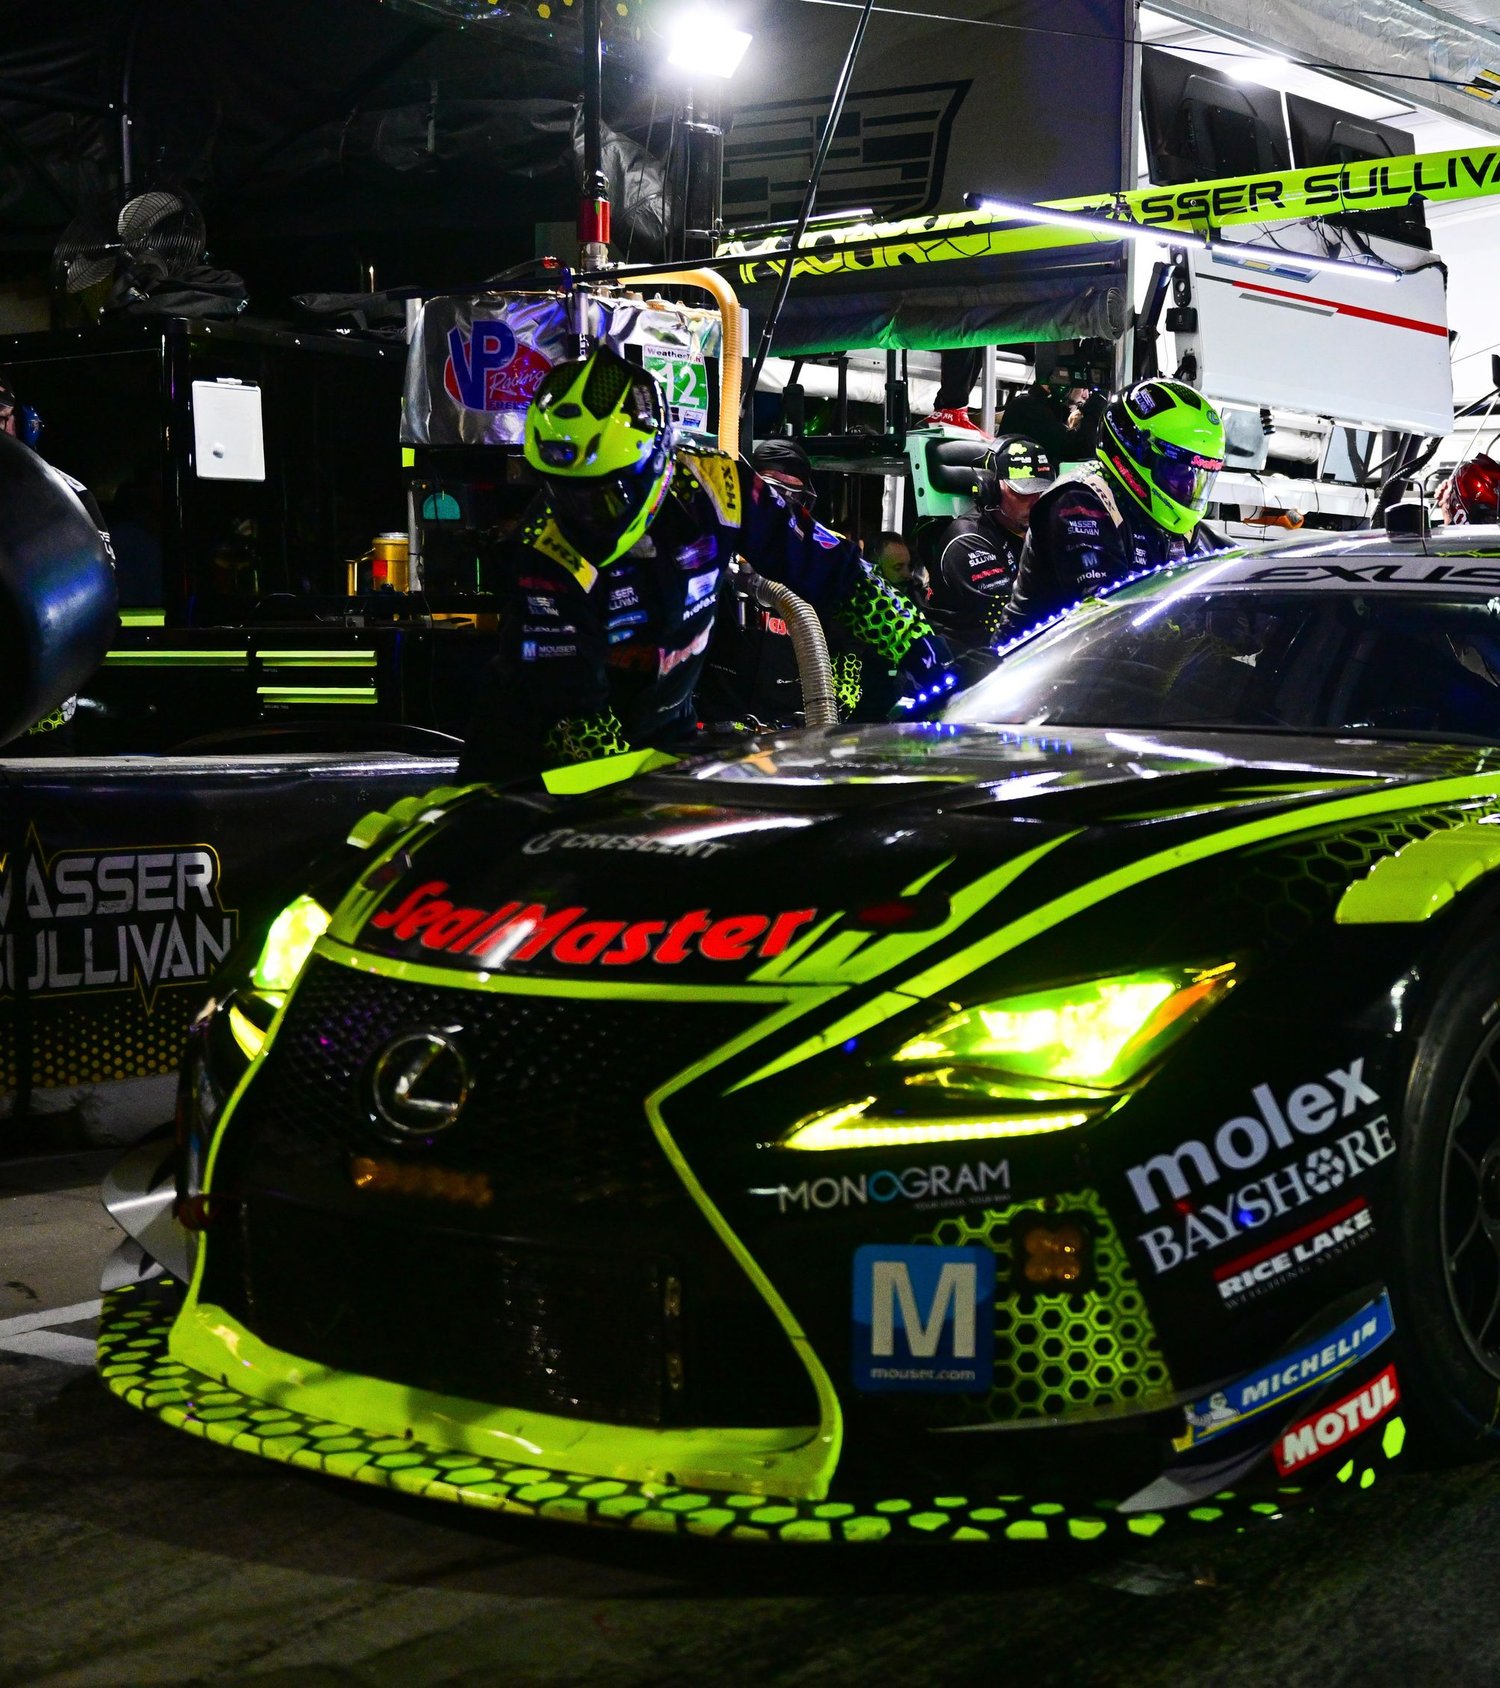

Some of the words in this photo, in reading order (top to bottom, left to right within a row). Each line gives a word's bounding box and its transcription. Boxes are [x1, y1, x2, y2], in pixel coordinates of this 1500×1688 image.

[1128, 179, 1287, 226] SSER
[447, 320, 518, 412] VP
[656, 362, 700, 407] 12
[1076, 569, 1108, 584] molex
[569, 832, 730, 860] CRESCENT
[0, 913, 232, 991] ULLIVAN
[370, 880, 818, 966] SealMaster
[1125, 1056, 1381, 1215] molex
[776, 1158, 1011, 1214] MONOGRAM
[1217, 1252, 1293, 1299] RICE
[1293, 1208, 1373, 1262] LAKE
[871, 1260, 977, 1358] M
[870, 1367, 977, 1381] mouser.com
[1241, 1316, 1377, 1407] MICHELIN
[1282, 1374, 1397, 1468] MOTUL
